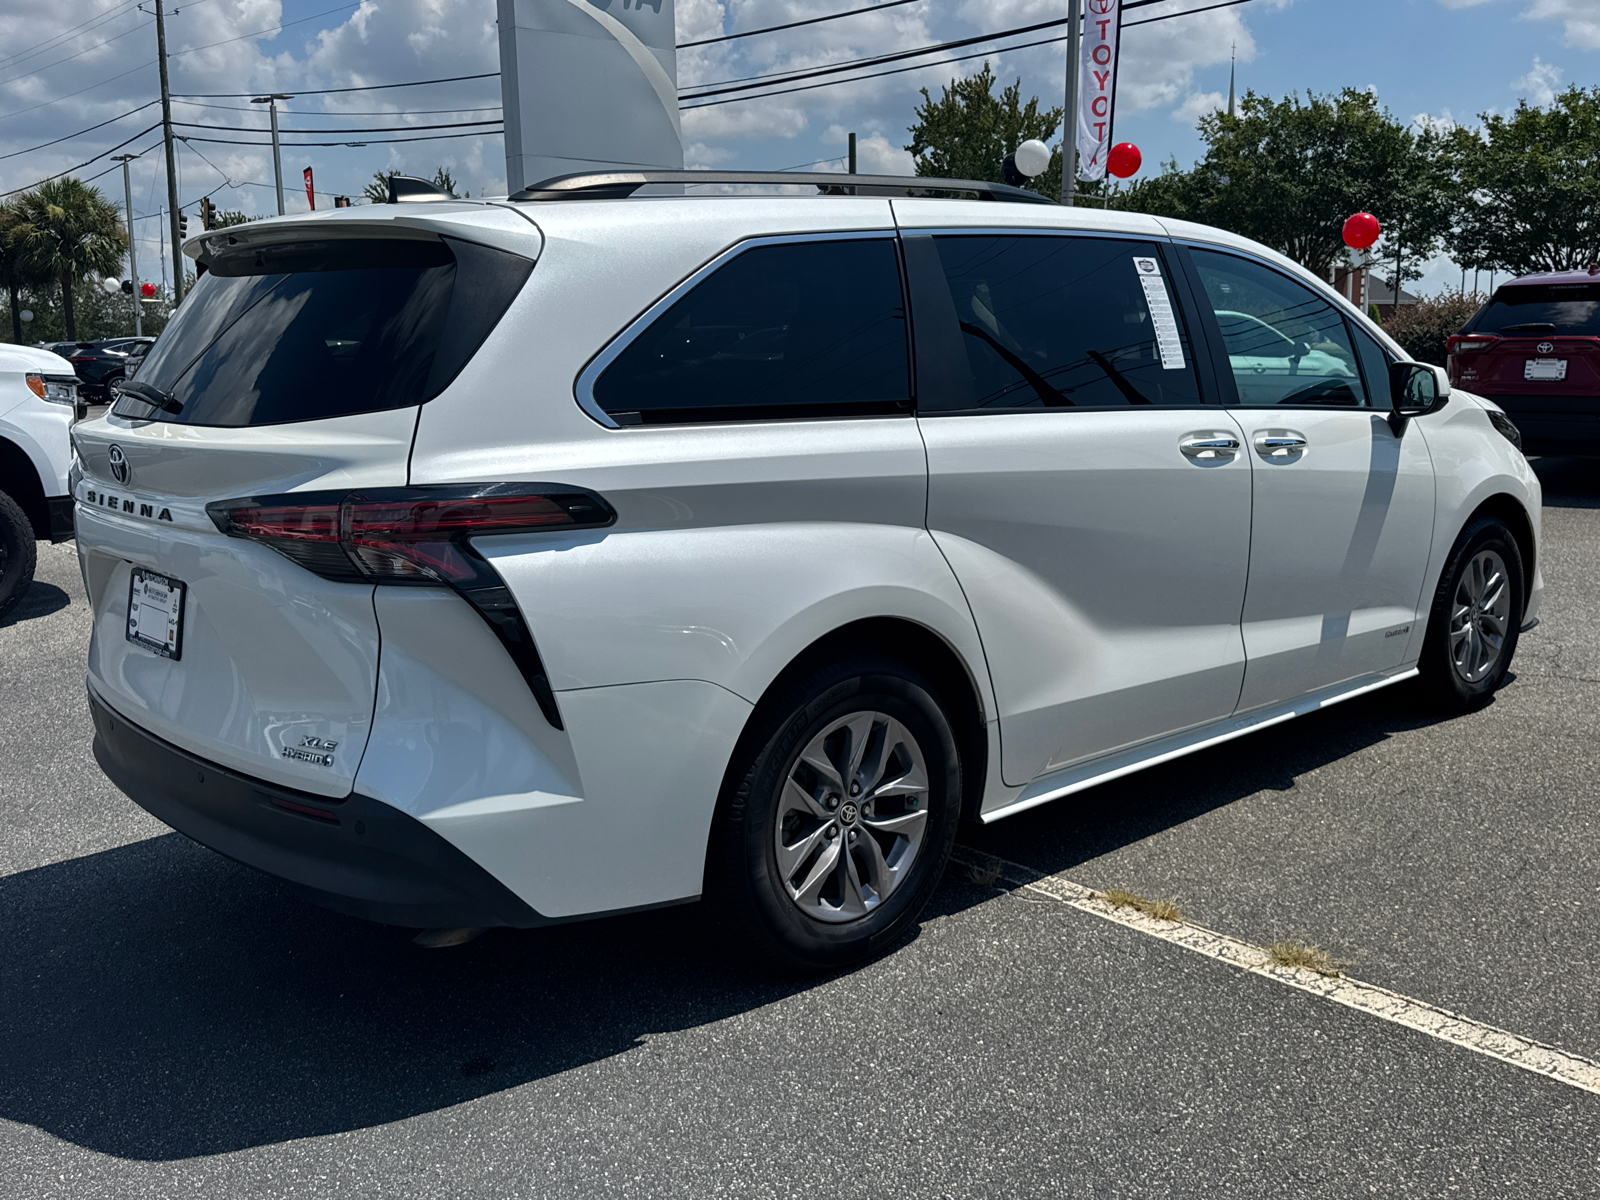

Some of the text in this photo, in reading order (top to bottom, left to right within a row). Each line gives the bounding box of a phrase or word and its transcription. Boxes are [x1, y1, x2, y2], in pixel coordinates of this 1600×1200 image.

[87, 490, 173, 522] SIENNA
[814, 683, 852, 712] DEFENDER
[281, 746, 326, 766] HYBRID
[298, 734, 339, 752] XLE
[763, 715, 806, 794] MICHELIN
